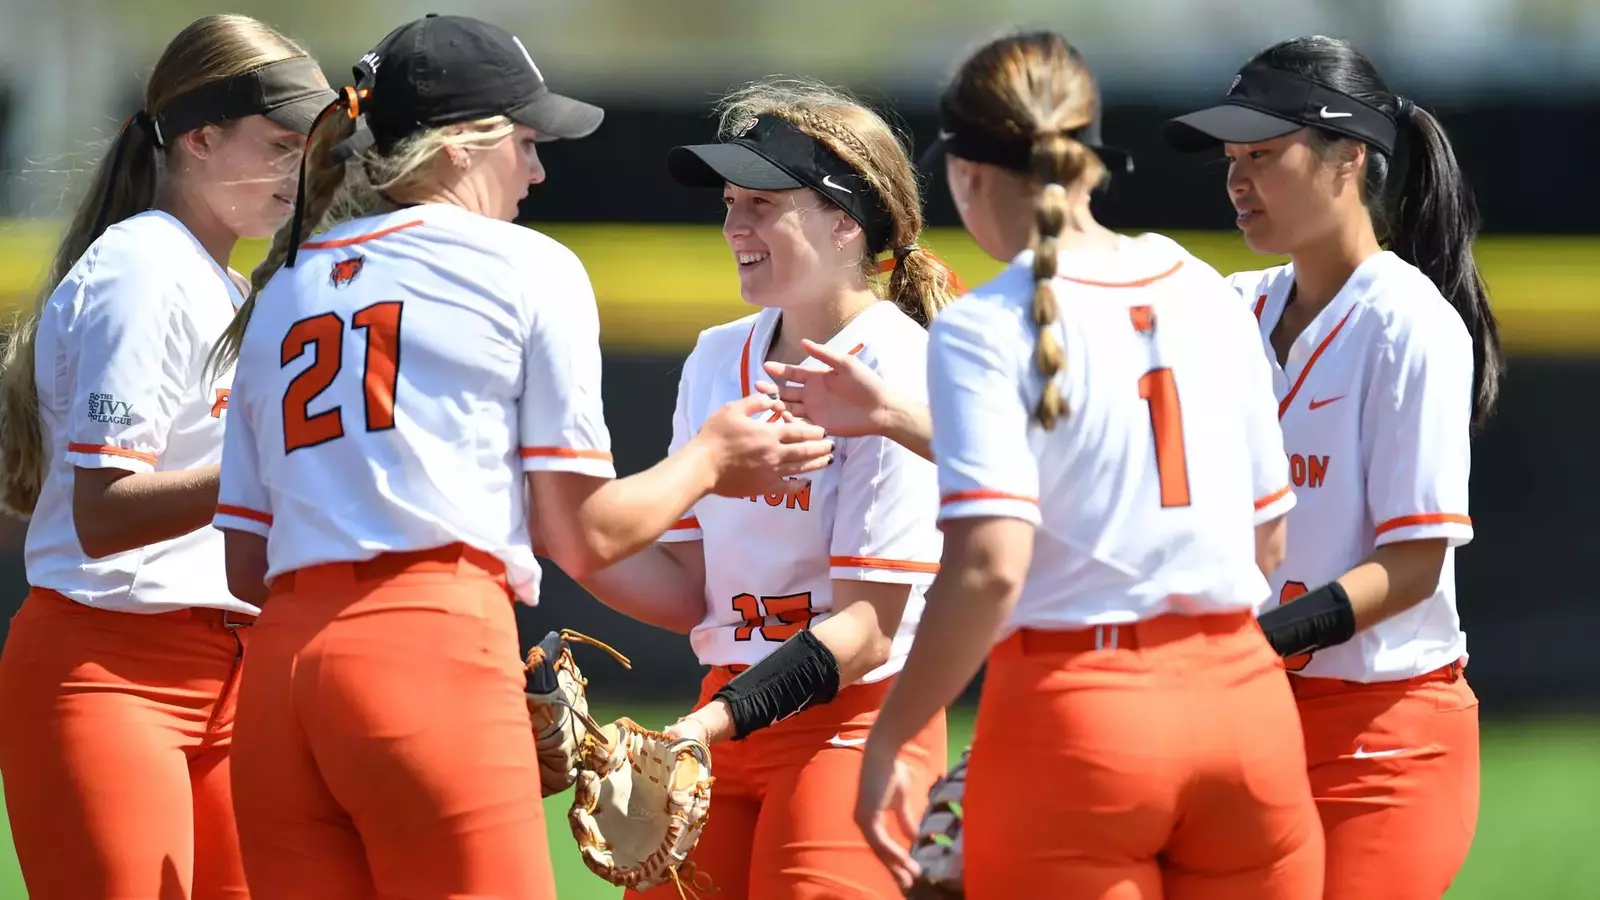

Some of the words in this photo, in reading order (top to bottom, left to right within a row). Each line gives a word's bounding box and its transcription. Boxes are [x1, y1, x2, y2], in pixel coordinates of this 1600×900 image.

[281, 301, 404, 455] 21
[98, 400, 134, 417] IVY
[98, 415, 132, 425] LEAGUE
[1138, 366, 1191, 507] 1
[1287, 453, 1330, 488] ON
[732, 591, 812, 642] 15
